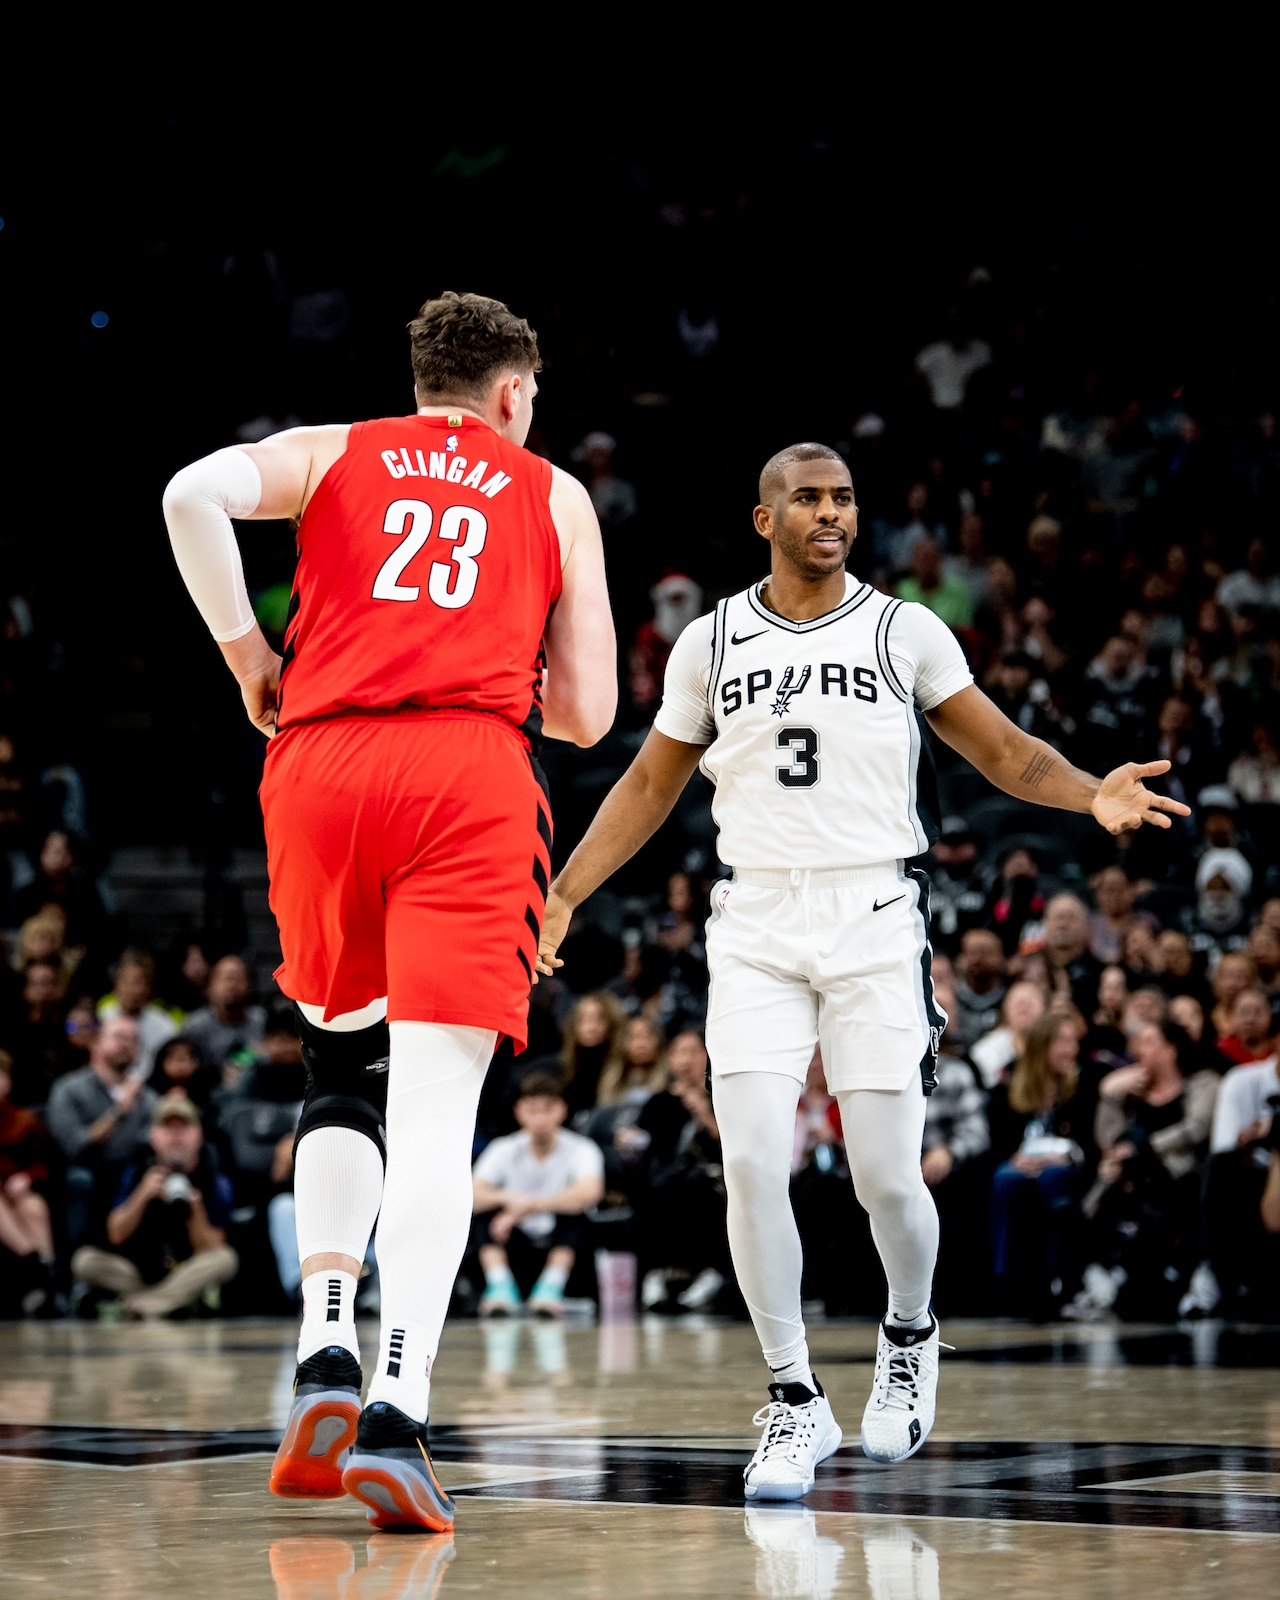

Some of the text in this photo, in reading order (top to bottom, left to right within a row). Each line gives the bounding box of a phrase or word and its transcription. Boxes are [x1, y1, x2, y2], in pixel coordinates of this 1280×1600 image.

[380, 447, 512, 499] CLINGAN
[371, 498, 489, 609] 23
[720, 663, 878, 718] SPURS
[775, 724, 821, 790] 3
